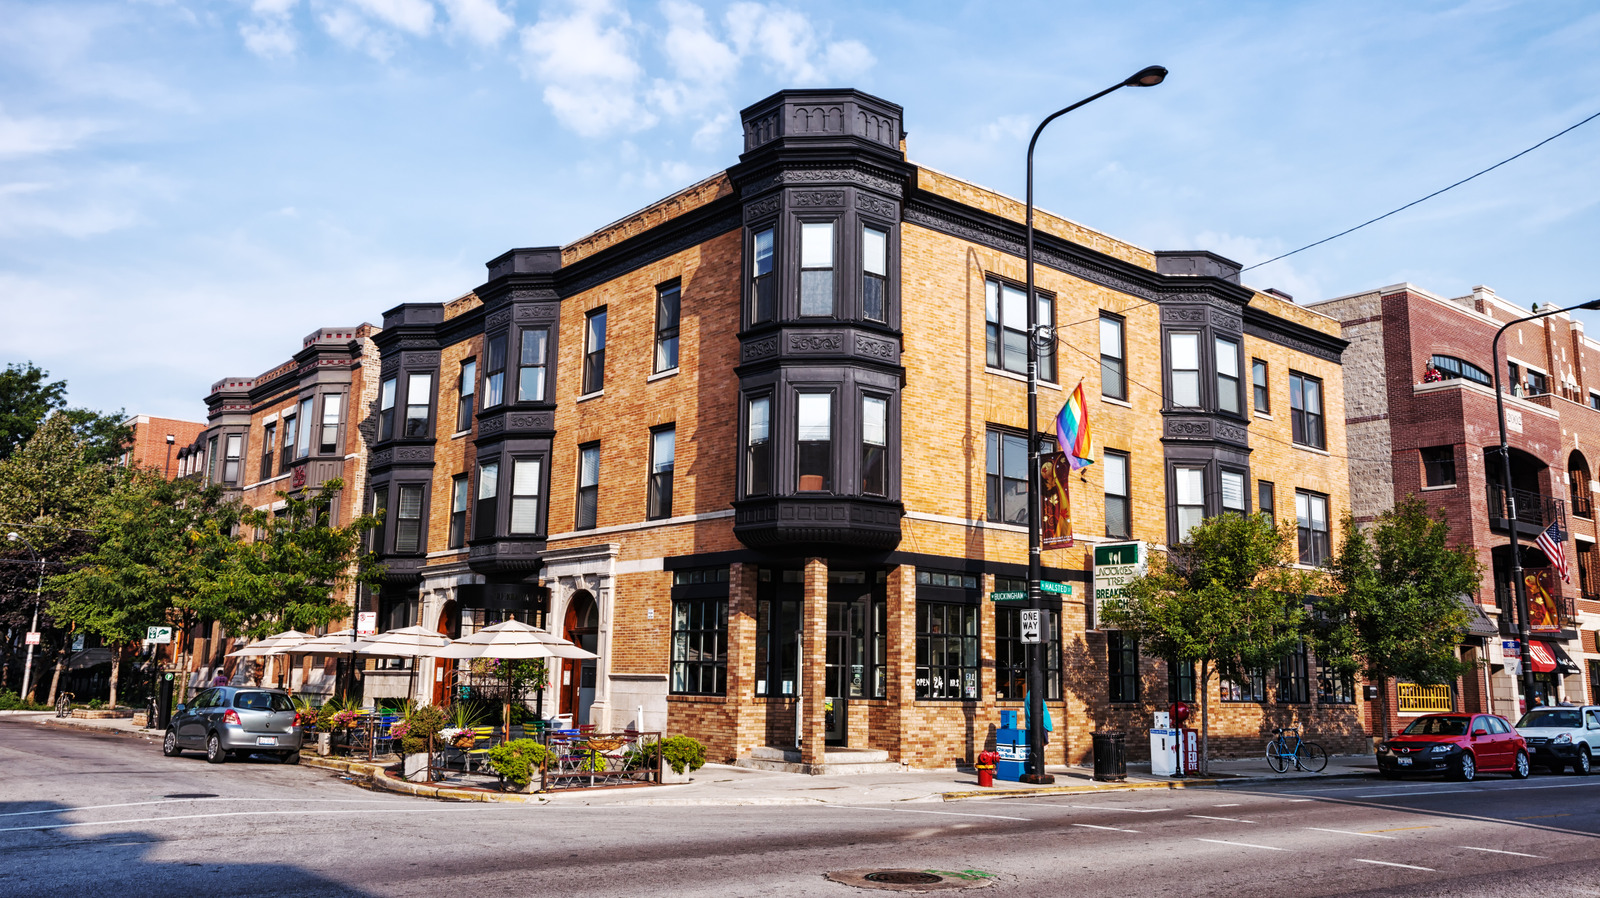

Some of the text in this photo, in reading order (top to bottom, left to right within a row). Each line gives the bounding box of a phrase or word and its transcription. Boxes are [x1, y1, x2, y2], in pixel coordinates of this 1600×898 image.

[1044, 582, 1067, 593] HALSTED
[994, 592, 1024, 600] BUCKINGHAM
[1096, 588, 1134, 599] BREAKFAS
[1023, 612, 1037, 621] ONE
[1023, 622, 1038, 630] WAY
[934, 676, 944, 689] 24
